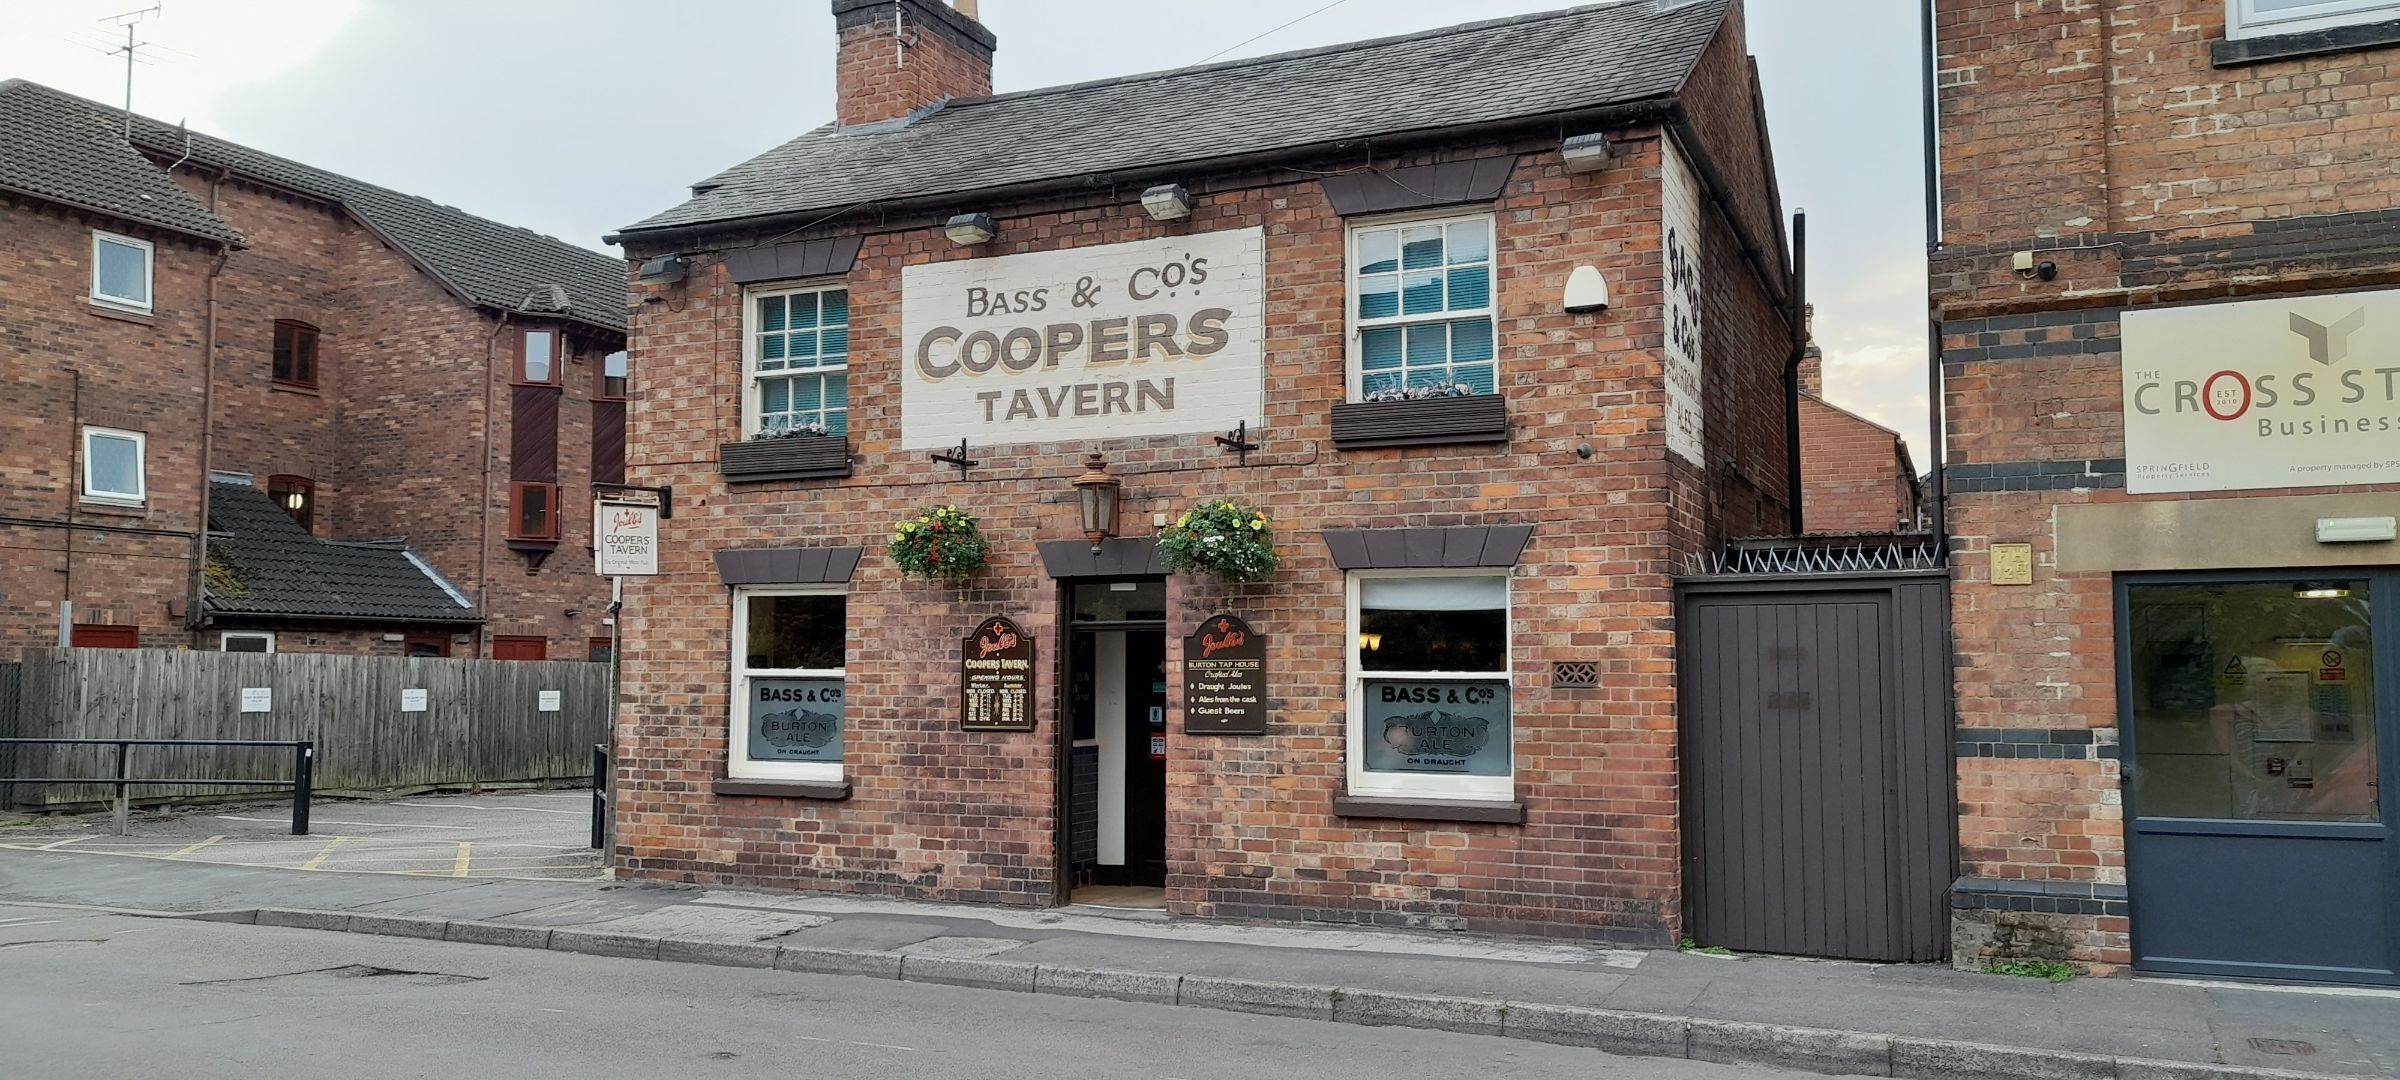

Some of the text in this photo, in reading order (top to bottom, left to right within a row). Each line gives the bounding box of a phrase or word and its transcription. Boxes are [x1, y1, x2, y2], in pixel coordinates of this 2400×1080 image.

[1668, 226, 1699, 328] BASS
[966, 286, 1049, 317] BASS
[1071, 275, 1102, 309] &
[915, 307, 1234, 383] COOPERS
[2135, 370, 2161, 380] THE
[2134, 370, 2316, 421] CROSS
[2217, 389, 2237, 398] EST
[976, 377, 1175, 423] TAVERN
[2217, 398, 2237, 406] 2010
[2258, 414, 2400, 437] Busines
[2136, 462, 2210, 473] SPRINGFIELD
[2297, 464, 2332, 473] property
[2334, 461, 2372, 471] managed
[2373, 461, 2384, 469] by
[605, 534, 650, 545] COOPERS
[610, 545, 648, 555] TAVERN
[966, 658, 1000, 670] COOPERS
[1198, 682, 1252, 692] Draught Joules
[760, 687, 803, 702] BASS
[806, 689, 816, 702] &
[1381, 686, 1441, 703] BASS
[1446, 689, 1460, 704] &
[1198, 707, 1245, 715] Guest Beers
[771, 721, 827, 731] BURTON
[786, 733, 811, 742] ALE
[1419, 739, 1453, 750] ALE
